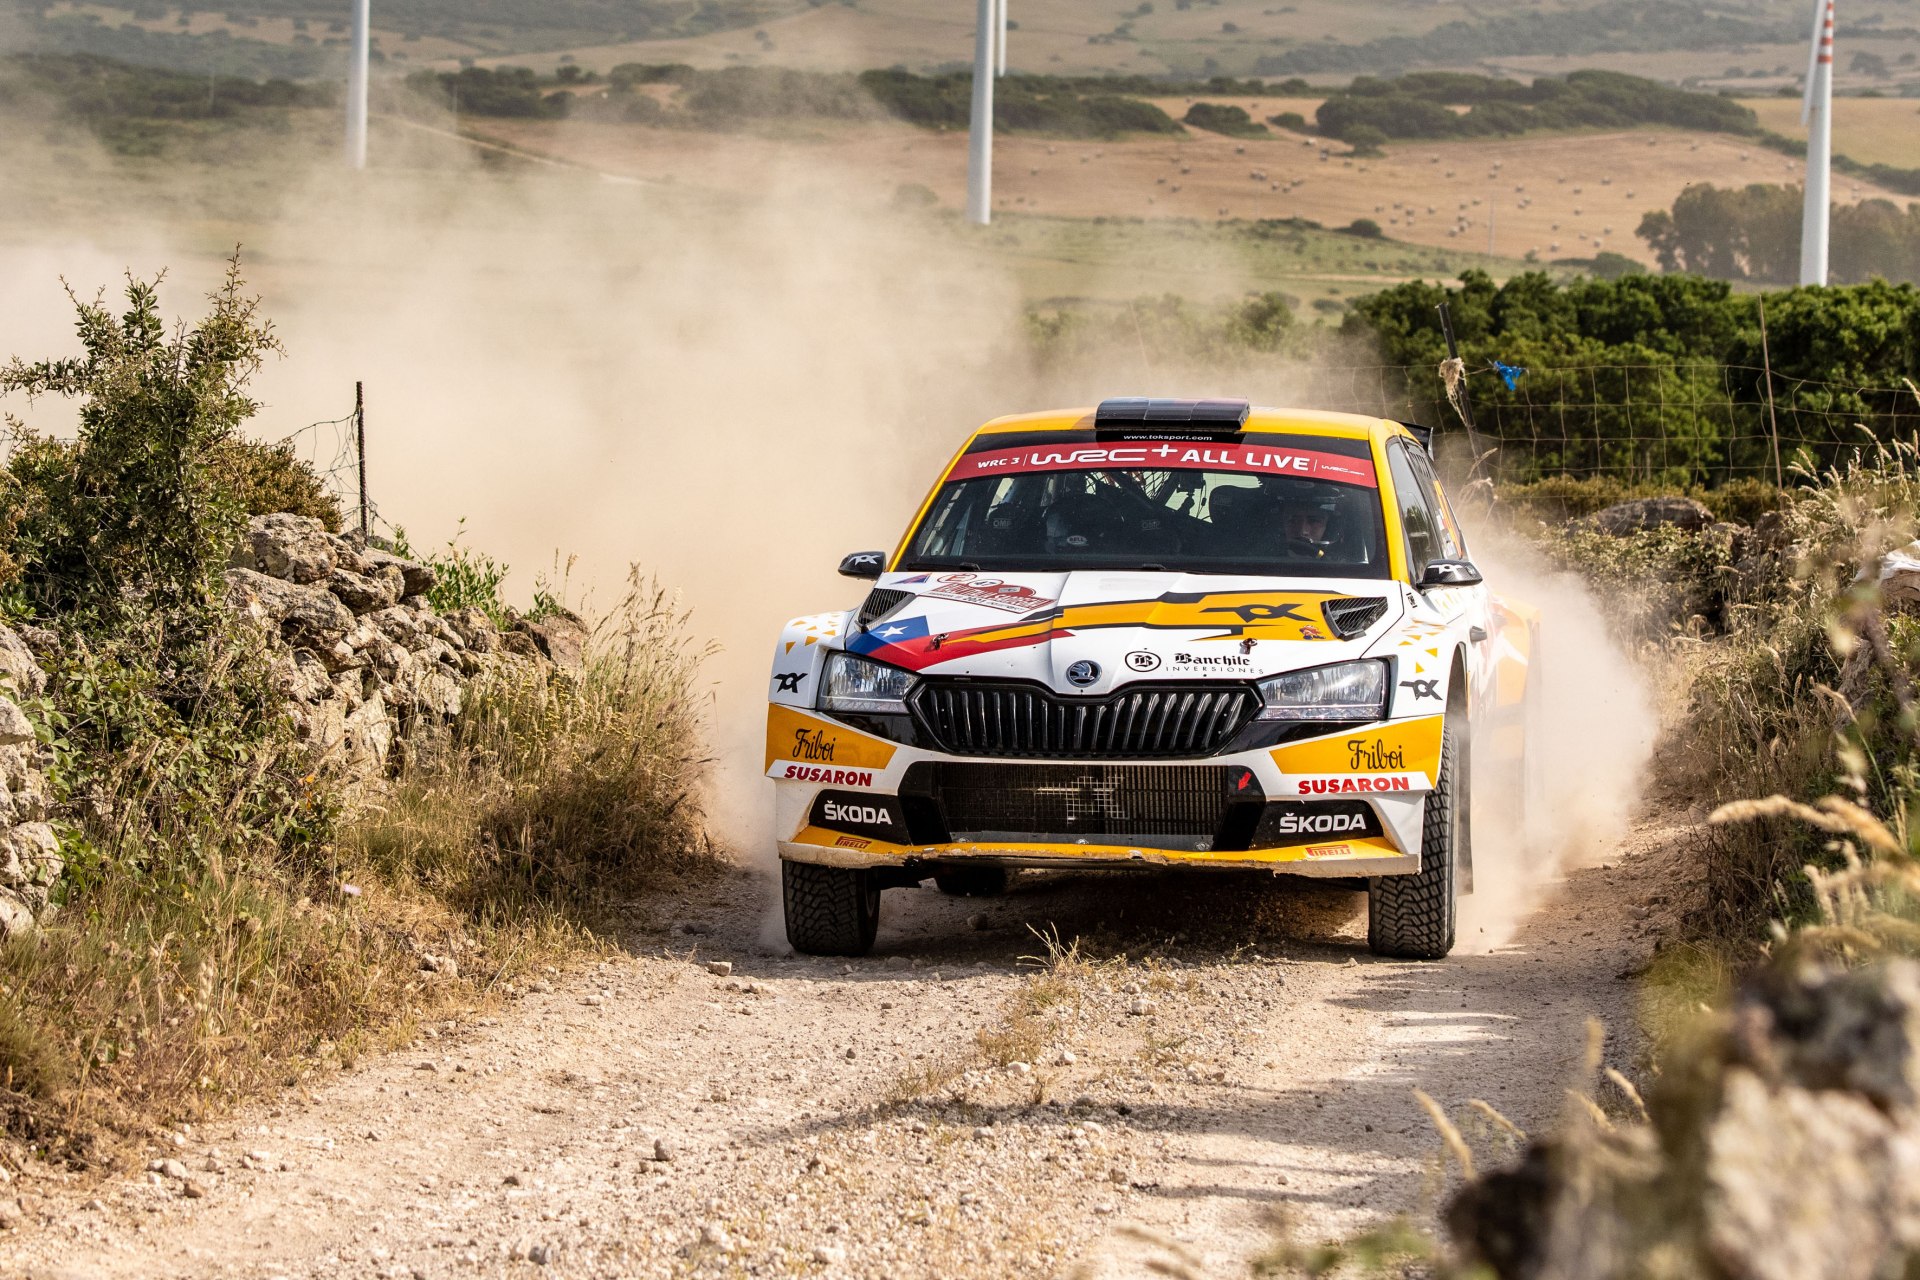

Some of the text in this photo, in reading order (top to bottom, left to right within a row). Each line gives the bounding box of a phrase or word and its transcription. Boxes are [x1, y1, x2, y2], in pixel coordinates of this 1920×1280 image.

[978, 458, 1007, 468] WRC
[1011, 457, 1020, 465] 3
[1180, 449, 1236, 464] ALL
[1245, 452, 1311, 471] LIVE
[1174, 652, 1251, 666] Banchile
[1165, 666, 1265, 674] INVERSIONES
[792, 728, 836, 761] Friboi
[1347, 739, 1406, 769] Friboi
[784, 765, 872, 787] SUSARON
[1298, 777, 1410, 795] SUSARON
[824, 800, 892, 825] ŠKODA
[1279, 812, 1366, 833] ŠKODA
[835, 836, 872, 849] PIRELLI
[1306, 844, 1351, 856] PIRELLI
